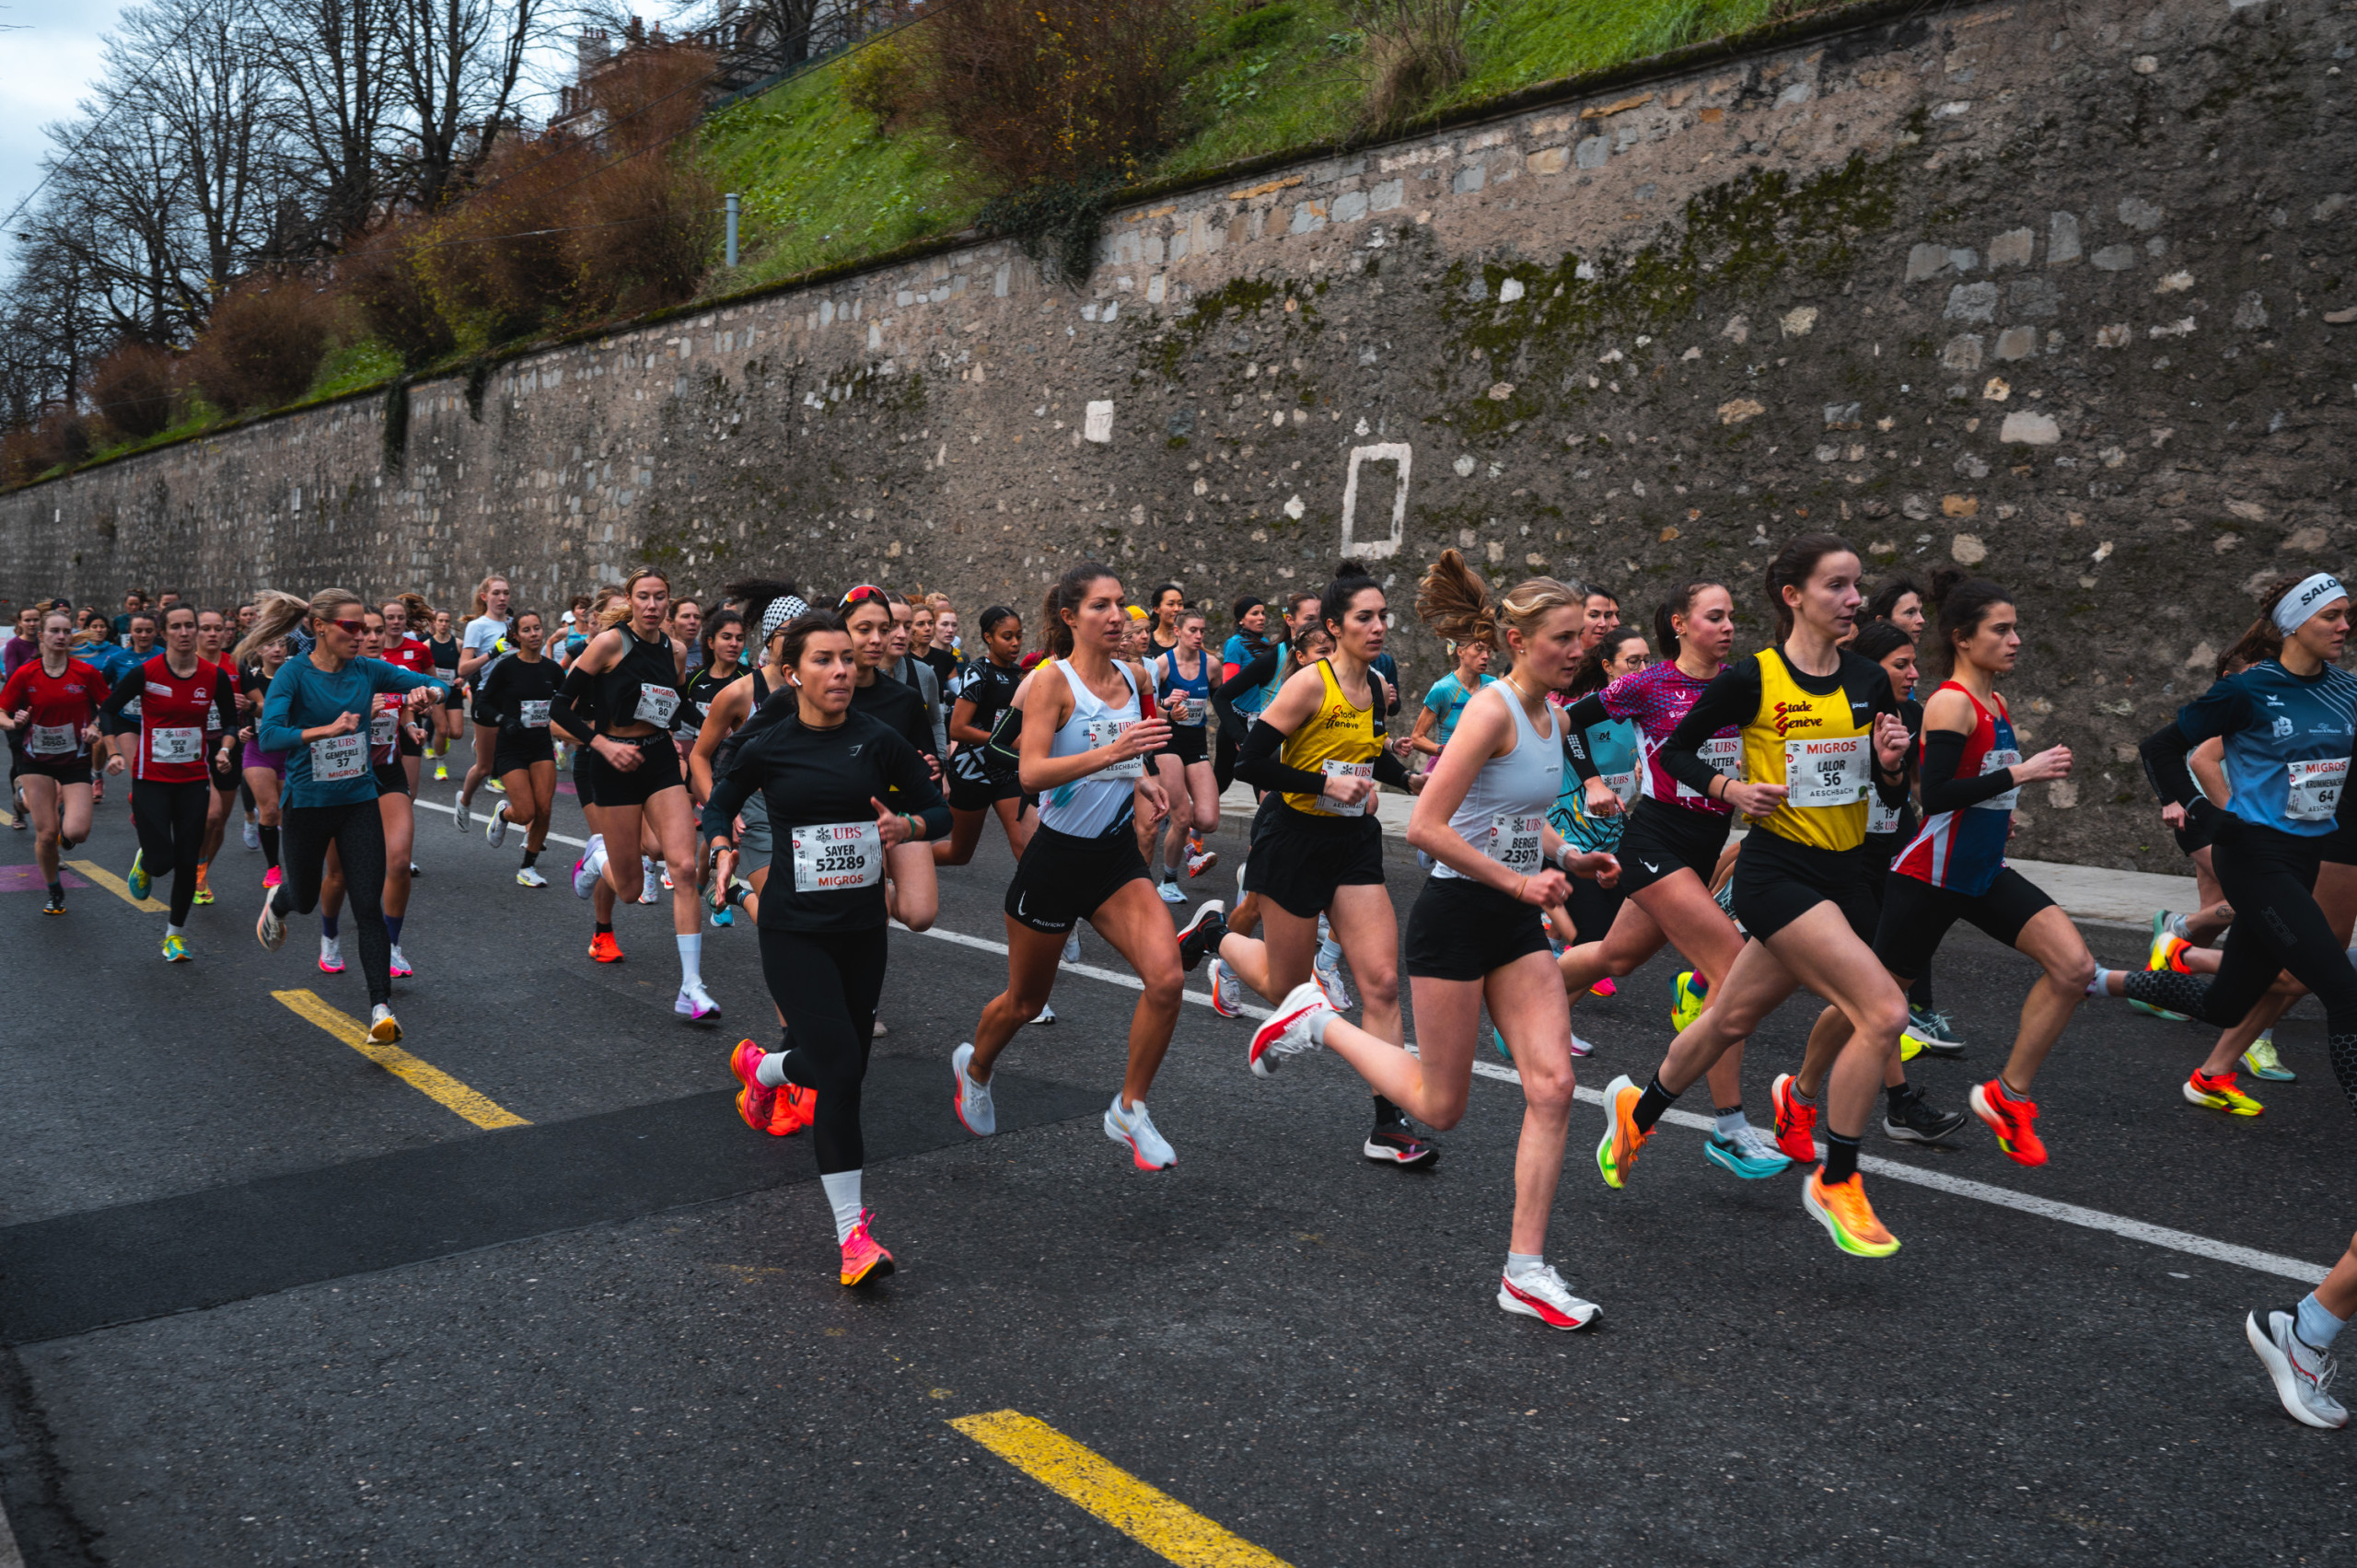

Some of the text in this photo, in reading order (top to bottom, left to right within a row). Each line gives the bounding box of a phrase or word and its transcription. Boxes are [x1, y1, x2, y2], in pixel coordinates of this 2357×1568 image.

[655, 698, 672, 708] PINTER
[658, 707, 668, 716] 80
[1332, 704, 1356, 718] Stade
[1772, 702, 1812, 721] Stade
[1326, 714, 1359, 729] Genève
[1775, 716, 1823, 737] Genève
[338, 737, 356, 748] UBS
[1714, 741, 1737, 753] UBS
[1806, 740, 1858, 755] MIGROS
[325, 748, 359, 760] GEMPERLE
[336, 758, 350, 767] 37
[1106, 762, 1142, 772] AESCHBACH
[1817, 760, 1846, 772] LALOR
[2305, 761, 2347, 774] MIGROS
[328, 768, 359, 778] MIGROS
[1354, 766, 1371, 776] UBS
[1613, 774, 1629, 784] UBS
[1823, 772, 1841, 787] 56
[2305, 777, 2346, 789] KRUMMENACHE
[1809, 787, 1854, 797] AESCHBACH
[2318, 790, 2334, 803] 64
[1885, 808, 1895, 819] 19
[2307, 803, 2337, 812] AESCHBA
[1526, 818, 1542, 831] UBS
[833, 826, 862, 840] UBS
[1512, 836, 1538, 849] BERGER
[825, 844, 855, 856] SAYER
[1501, 848, 1538, 863] 23978
[816, 855, 865, 872] 52289
[819, 874, 864, 887] MIGROS
